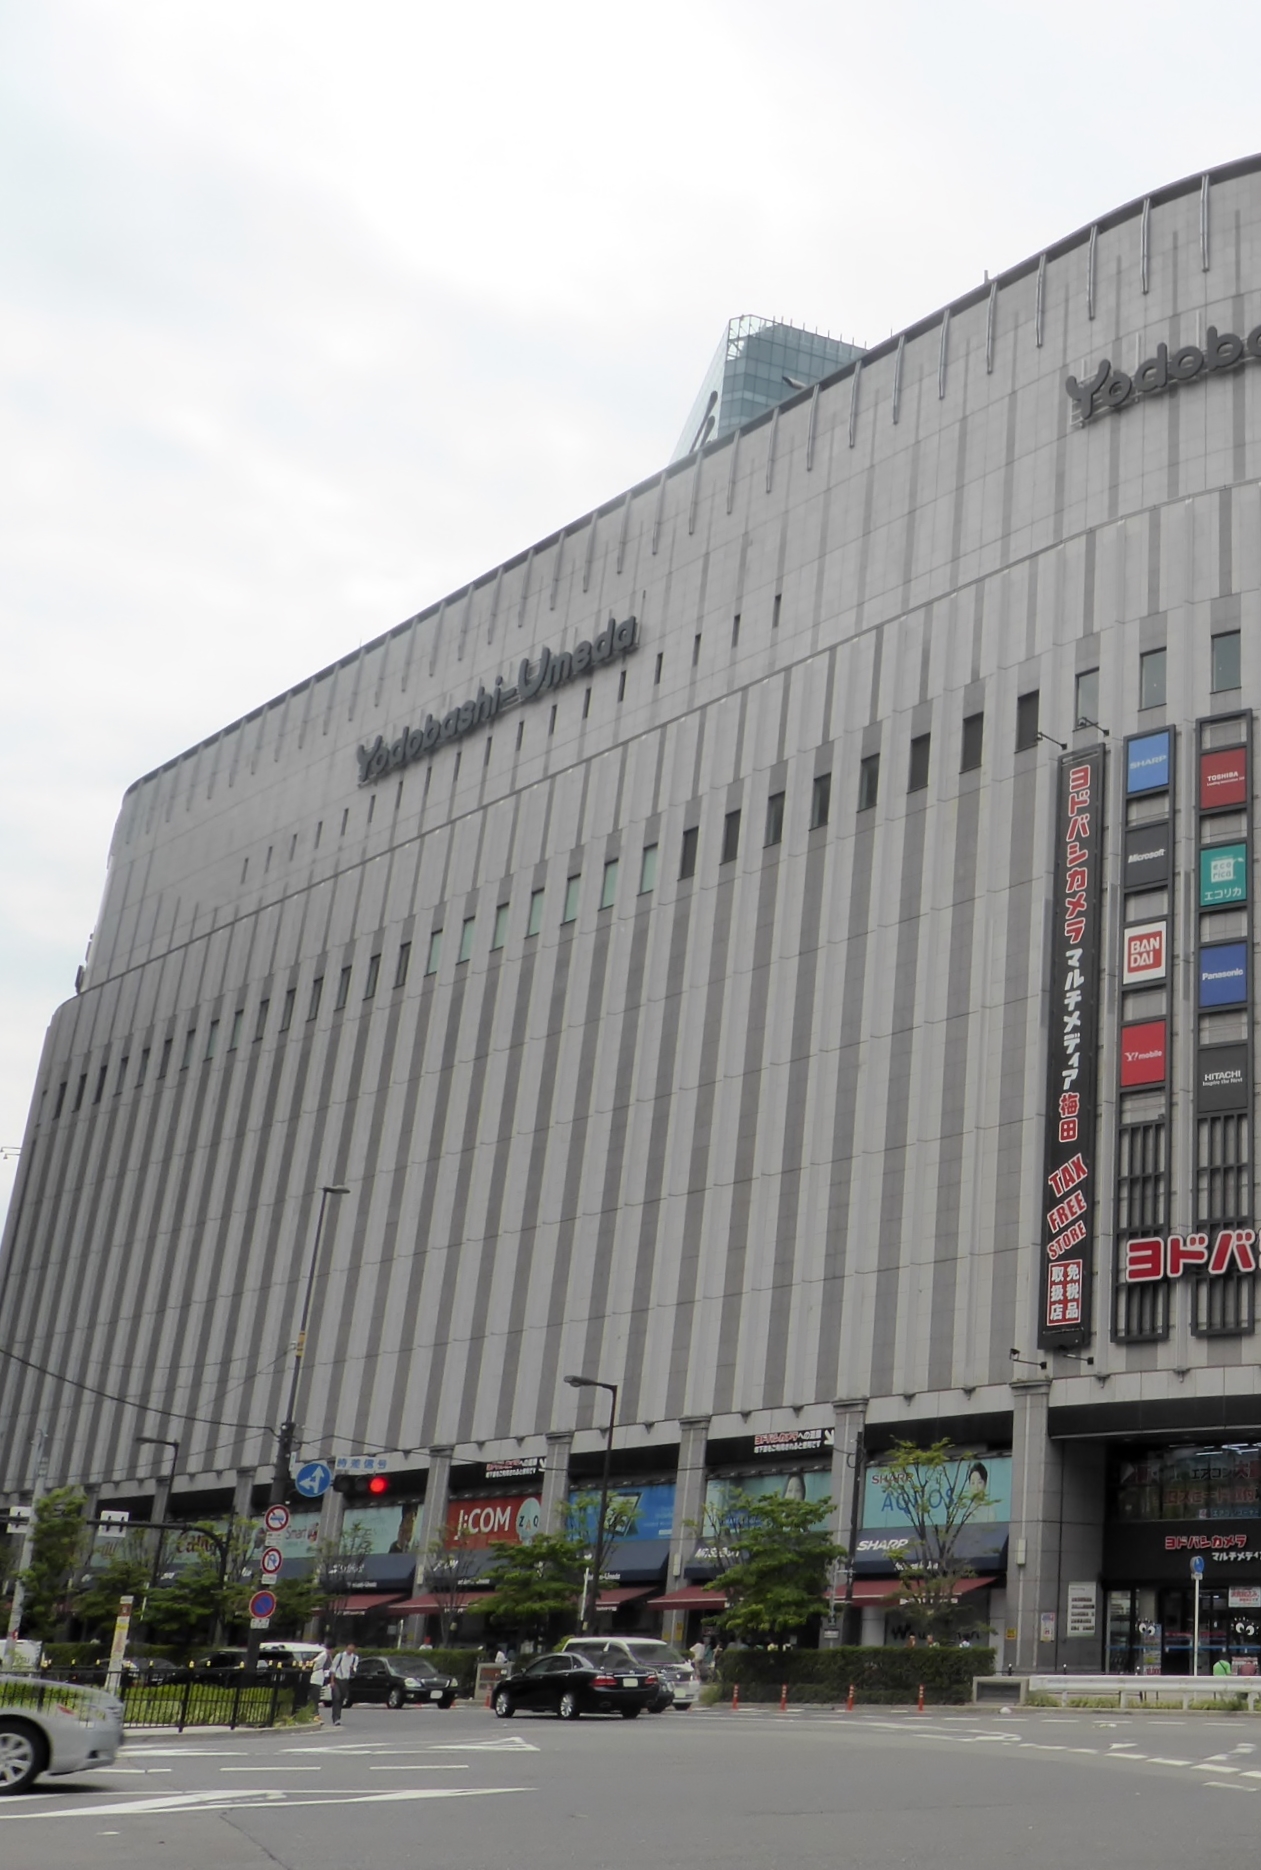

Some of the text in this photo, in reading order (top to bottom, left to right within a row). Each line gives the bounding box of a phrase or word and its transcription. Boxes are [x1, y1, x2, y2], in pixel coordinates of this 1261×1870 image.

[356, 615, 638, 783] Yodobashi-Umeda
[1129, 755, 1167, 770] SHARP
[1207, 771, 1239, 782] TOSHIBA
[1128, 848, 1165, 864] Microsoft
[1213, 862, 1232, 871] eco
[1213, 870, 1232, 880] rica
[1204, 886, 1242, 901] エコリカ
[1131, 937, 1160, 953] BAN
[1130, 951, 1154, 968] DAI
[1202, 968, 1244, 981] Panasonic
[1204, 1070, 1242, 1083] HITACHI
[1048, 1153, 1088, 1198] TAX
[1046, 1190, 1088, 1234] FREE
[1047, 1220, 1088, 1261] STORE
[1049, 1266, 1065, 1321] 取扱店
[1065, 1263, 1080, 1319] 免税品
[881, 1487, 955, 1515] AQOS
[453, 1505, 512, 1540] J:COM
[857, 1539, 908, 1551] SHARP
[1164, 1534, 1247, 1550] ヨドバシカメラ
